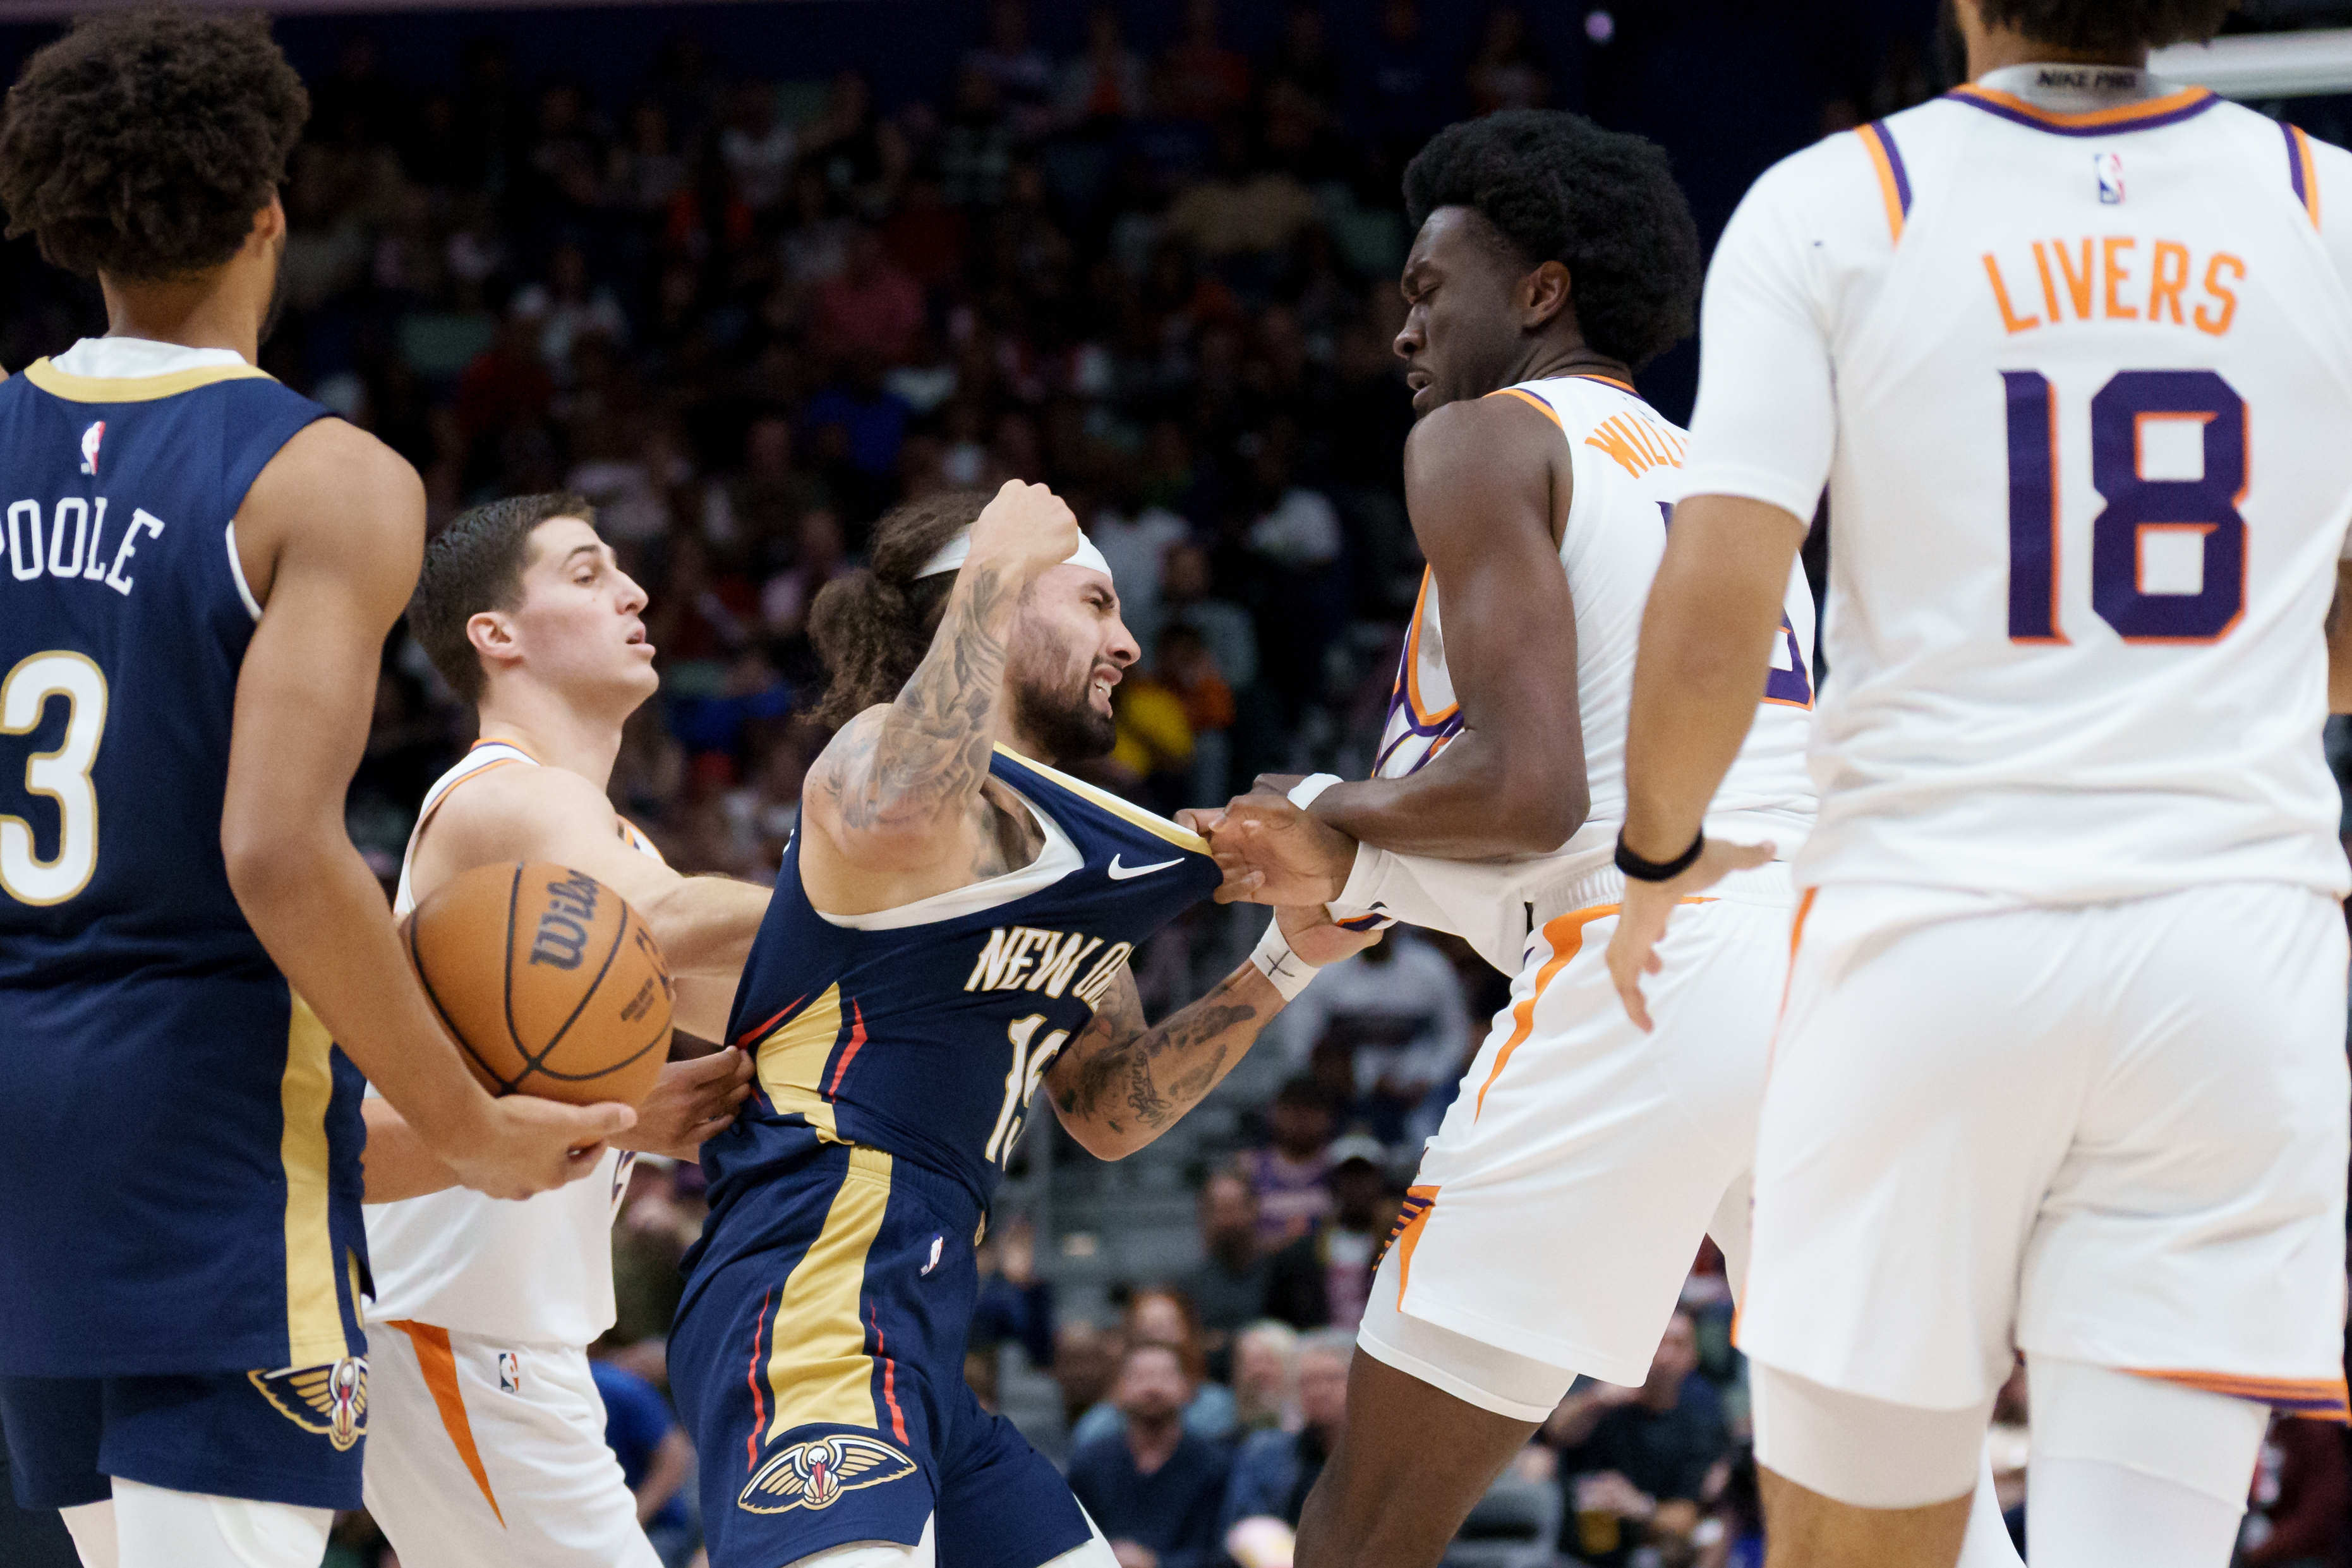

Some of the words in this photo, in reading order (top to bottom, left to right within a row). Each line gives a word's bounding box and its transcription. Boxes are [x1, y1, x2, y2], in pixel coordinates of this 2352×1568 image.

[1982, 236, 2246, 336] LIVERS
[0, 496, 166, 596] OOLE
[1999, 369, 2252, 646] 18
[0, 649, 109, 907] 3
[964, 926, 1104, 999] NEW
